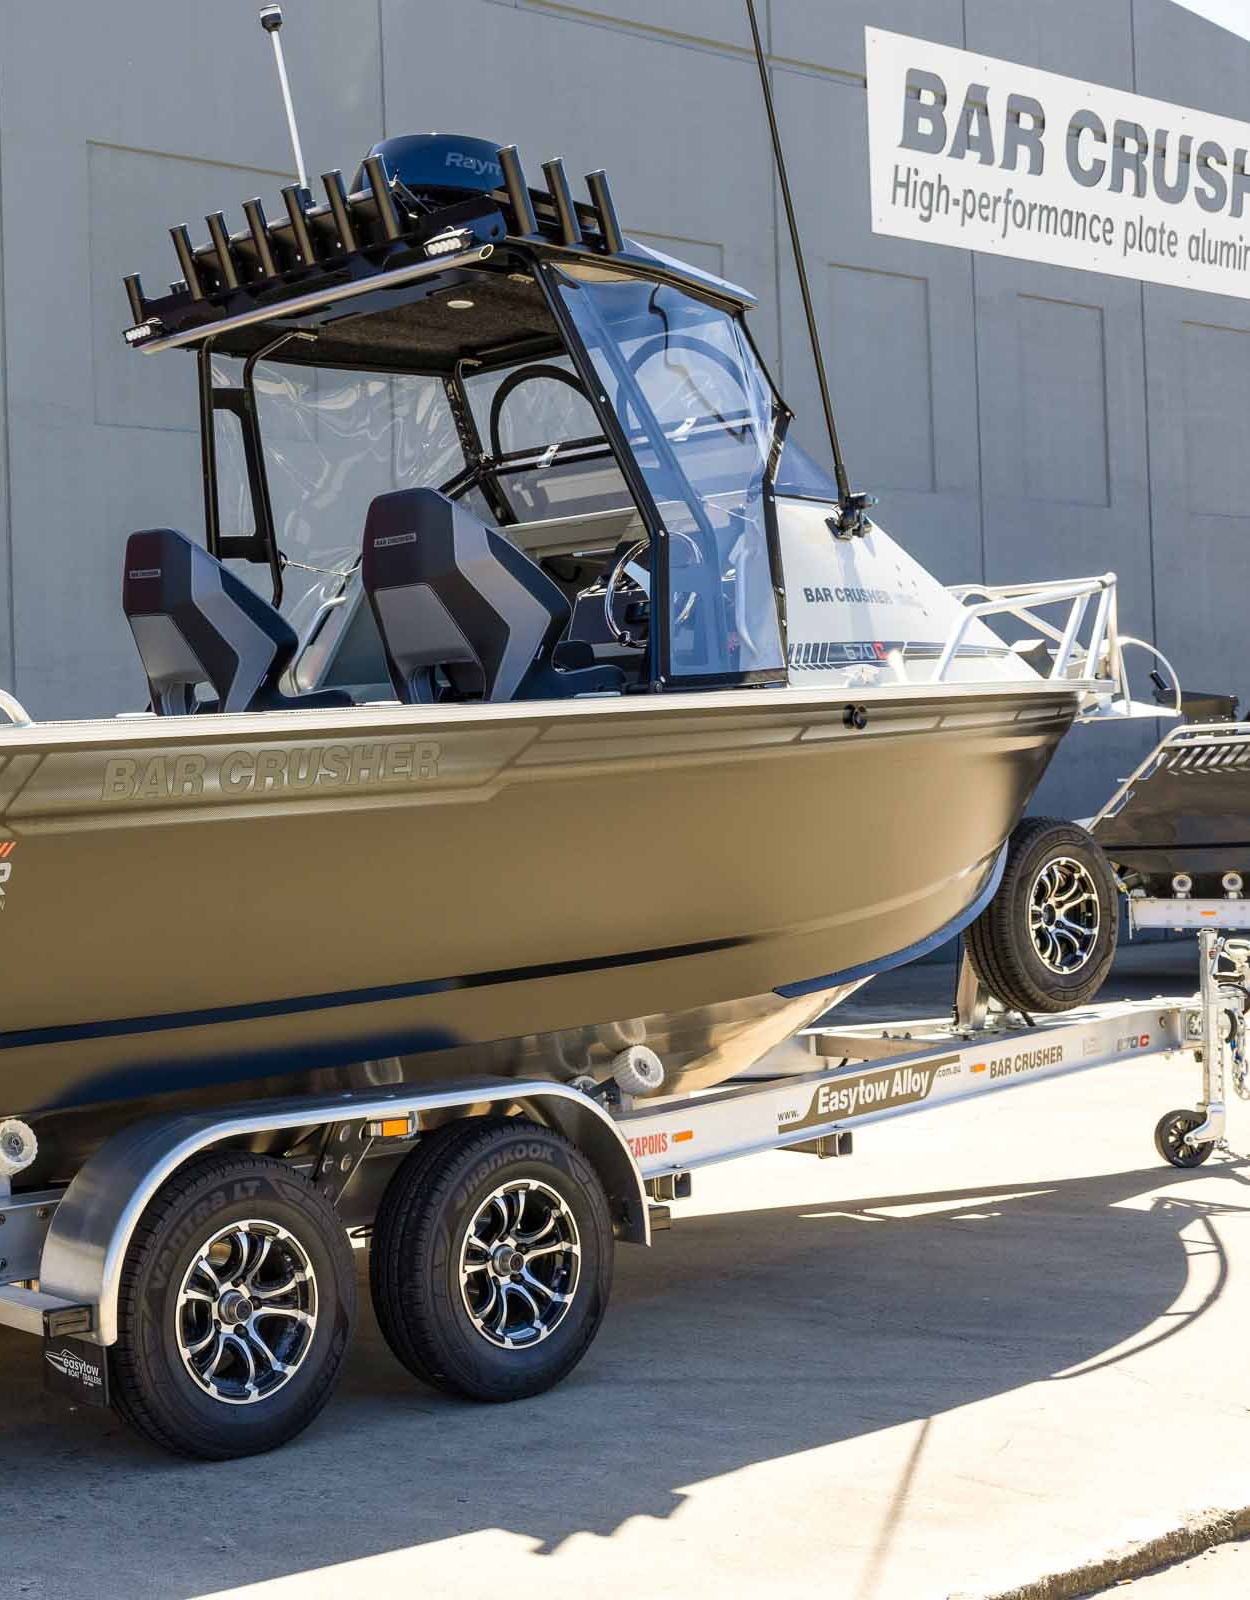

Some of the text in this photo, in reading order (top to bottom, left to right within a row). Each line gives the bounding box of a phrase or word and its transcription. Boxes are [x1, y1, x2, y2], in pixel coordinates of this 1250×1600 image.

[896, 67, 1046, 177] BAR
[891, 164, 1115, 247] High-performance
[1123, 215, 1180, 259] plate
[803, 586, 895, 606] BAR CRUSHER
[102, 740, 444, 801] BAR CRUSHER
[989, 1054, 1013, 1079] BAR
[1014, 1044, 1064, 1073] CRUSHER
[777, 1109, 800, 1122] www.
[816, 1079, 890, 1115] Easytow
[890, 1068, 932, 1098] Alloy
[63, 1358, 99, 1377] easytow
